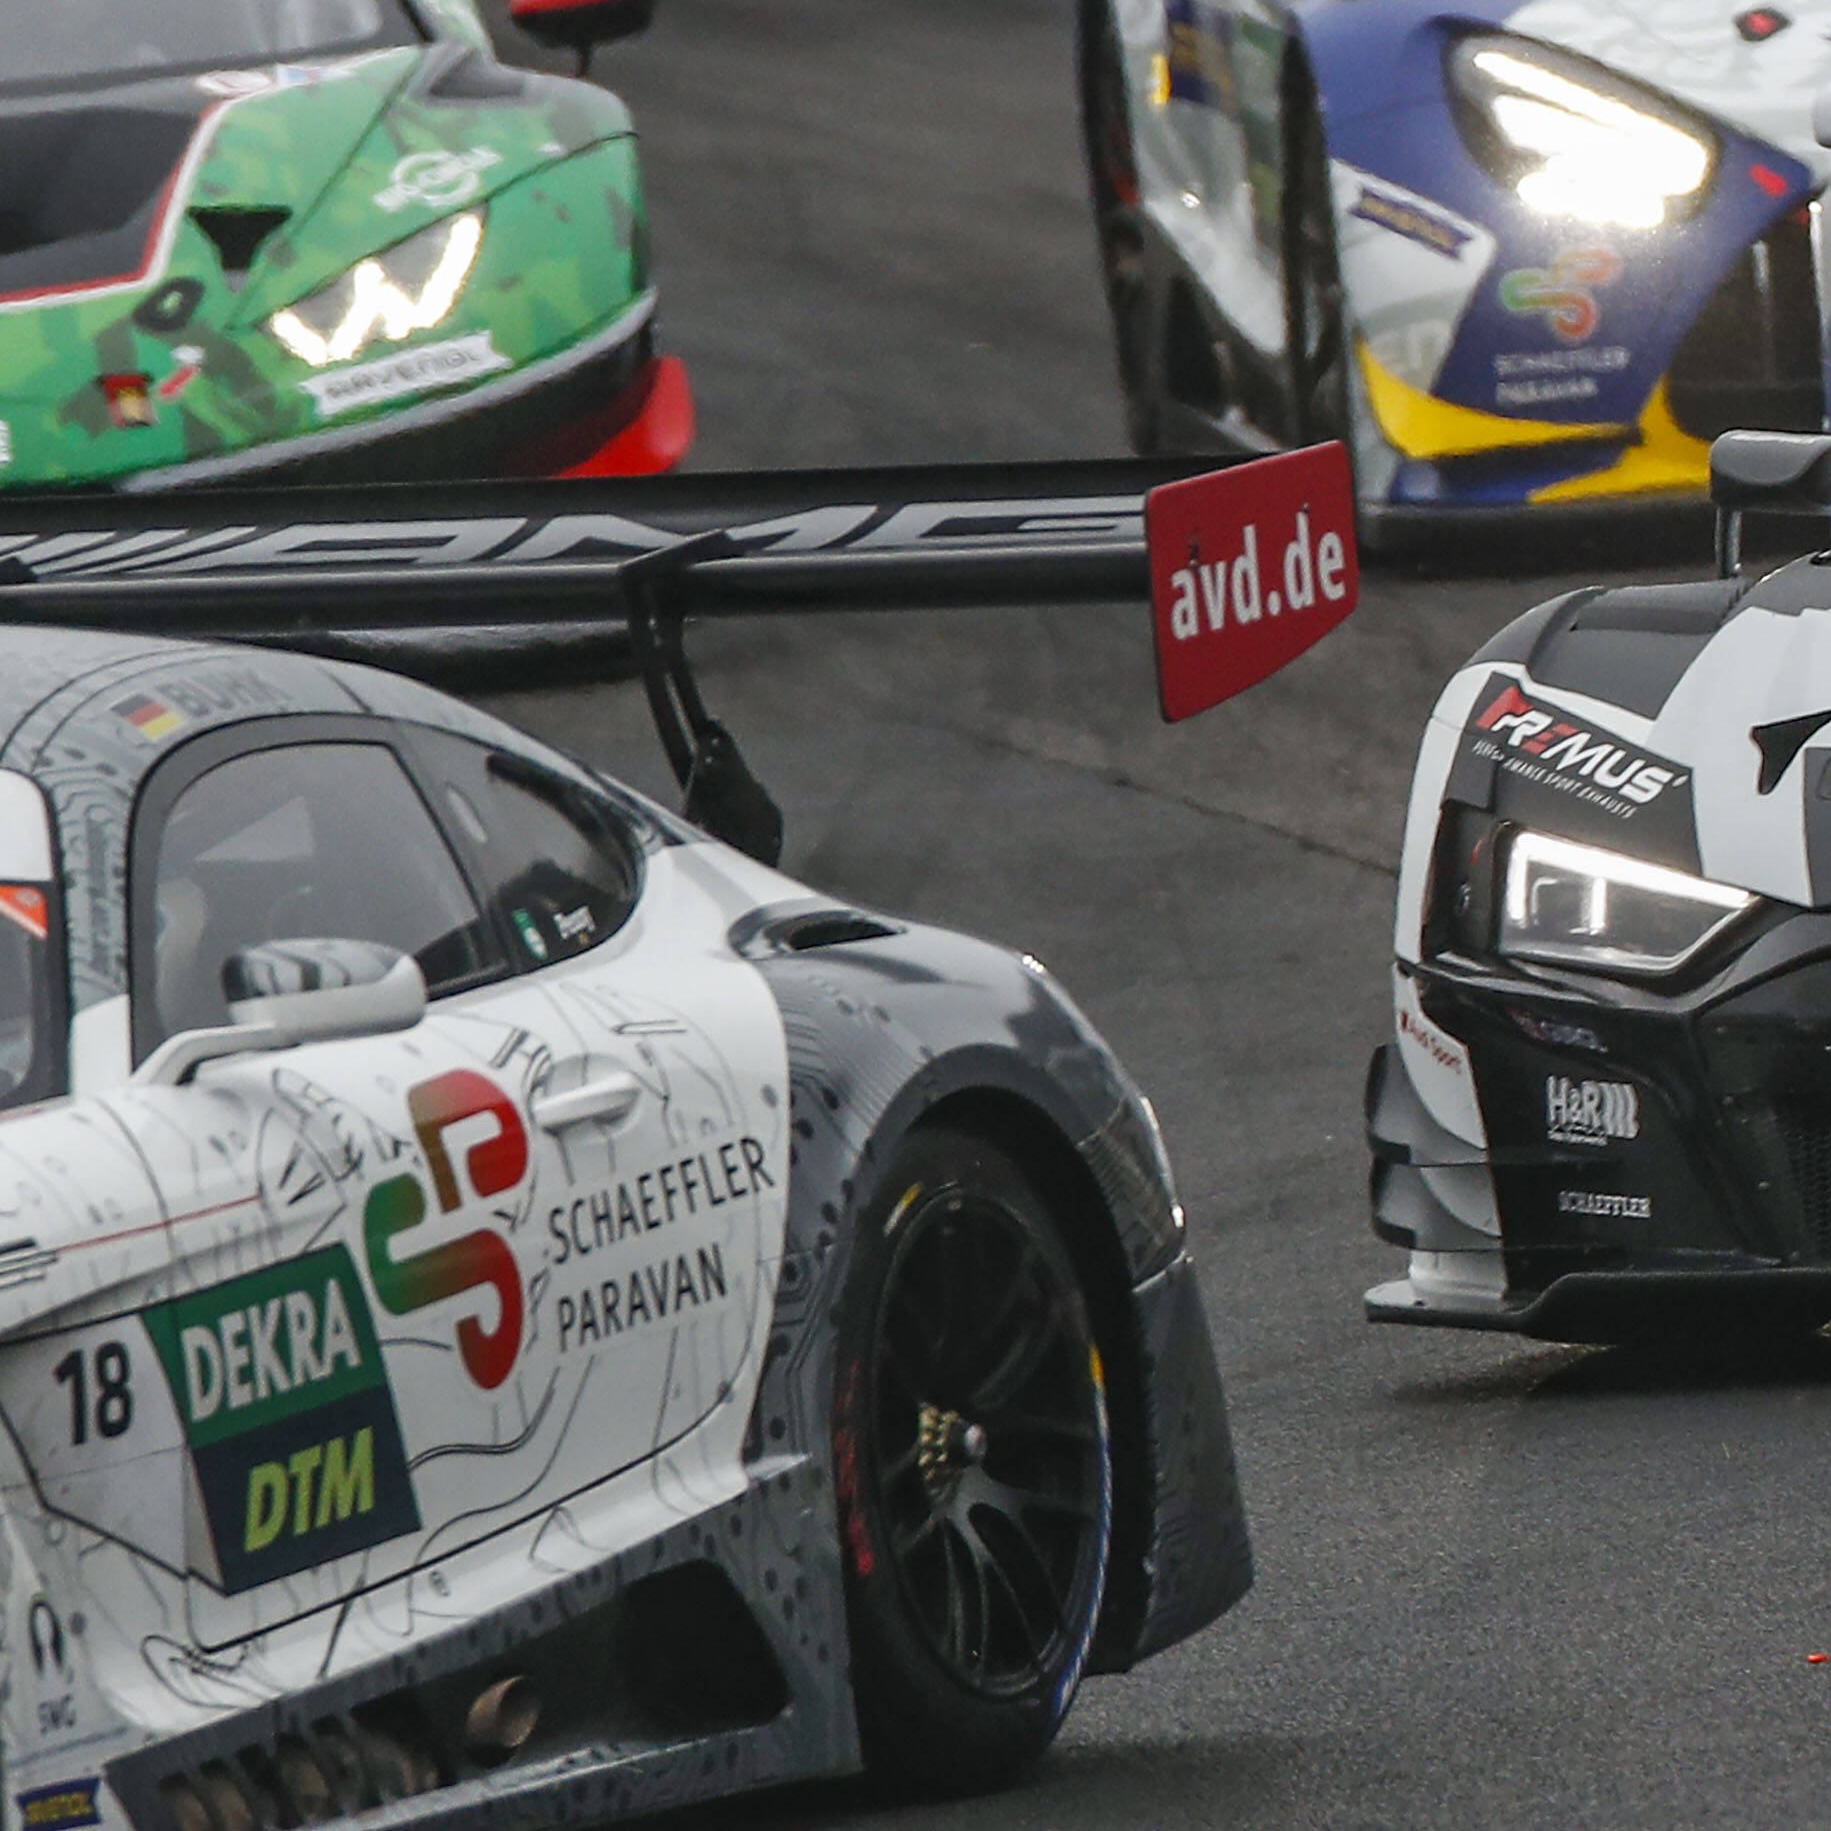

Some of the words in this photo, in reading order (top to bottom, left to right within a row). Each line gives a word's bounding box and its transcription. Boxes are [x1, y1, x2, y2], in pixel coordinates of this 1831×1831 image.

[1170, 510, 1347, 641] avd.de
[1490, 709, 1675, 805] REMUS
[550, 1137, 775, 1265] SCHAEFFLER
[180, 1276, 363, 1424] DEKRA
[557, 1241, 727, 1353] PARAVAN
[51, 1339, 134, 1449] 18
[242, 1427, 378, 1555] DTM
